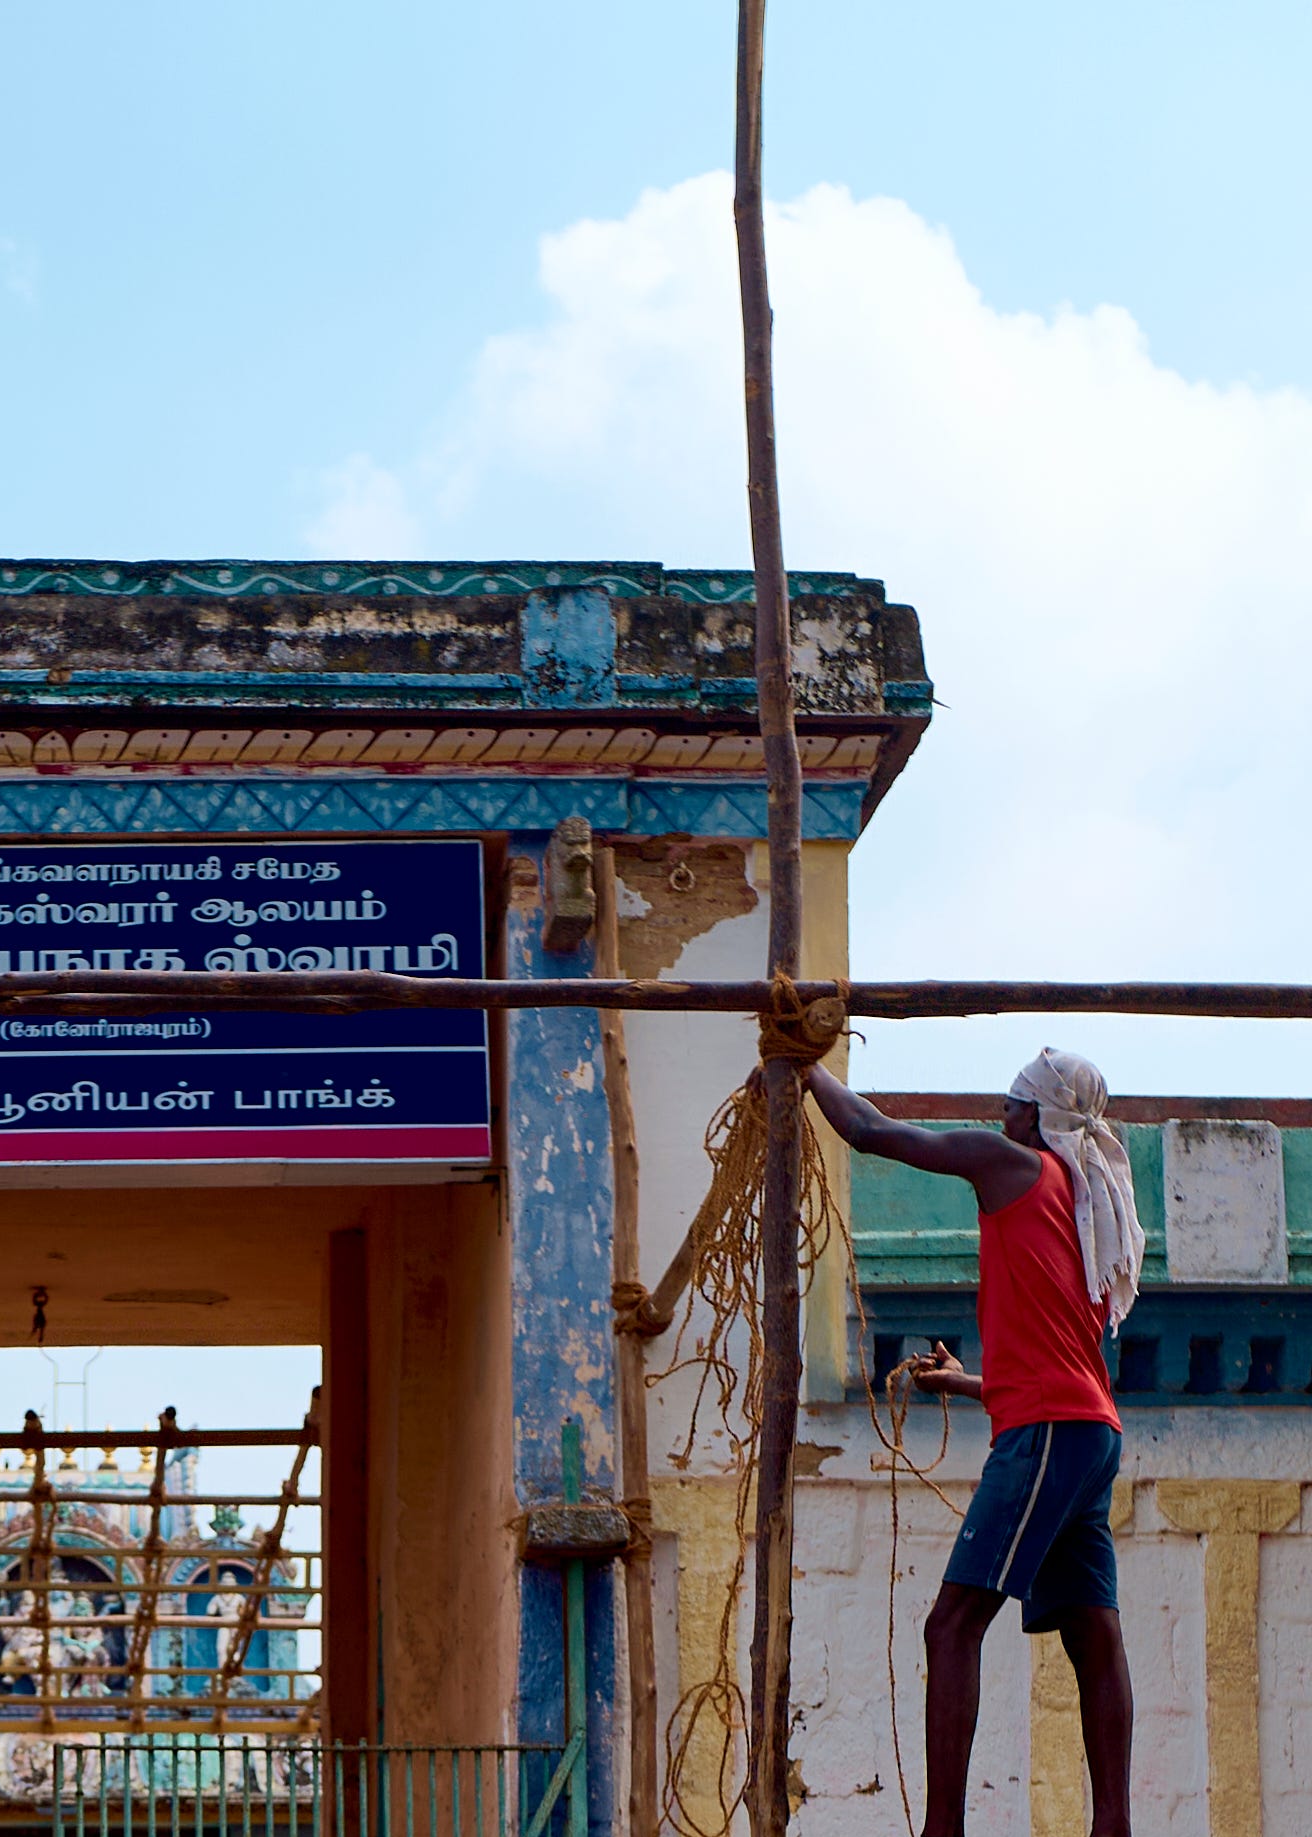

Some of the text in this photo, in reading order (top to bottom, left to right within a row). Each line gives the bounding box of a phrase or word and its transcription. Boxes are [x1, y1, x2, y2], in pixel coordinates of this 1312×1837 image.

[231, 857, 341, 884] சமேத
[190, 889, 387, 927] ஆலயம்
[234, 1077, 397, 1112] பாங்க்
